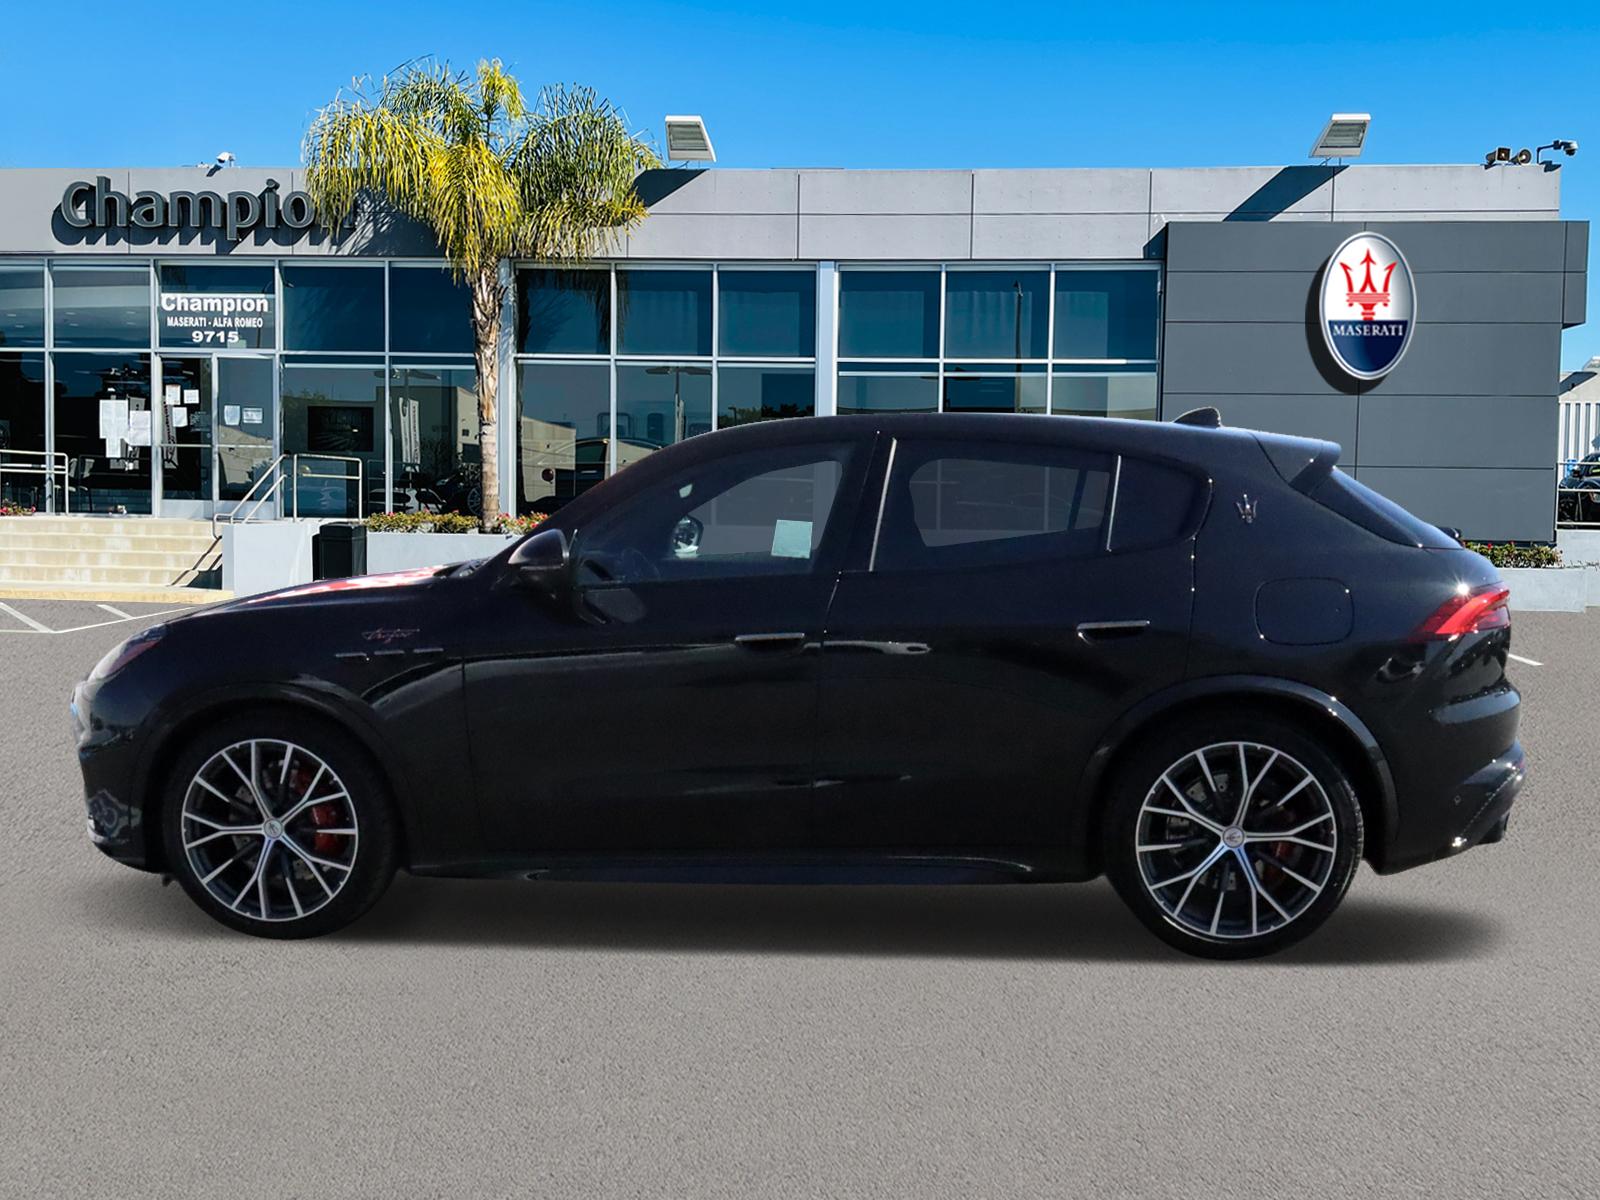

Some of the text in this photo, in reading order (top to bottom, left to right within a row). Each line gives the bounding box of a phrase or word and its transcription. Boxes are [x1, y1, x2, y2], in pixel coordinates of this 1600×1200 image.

[61, 176, 354, 241] Champio
[160, 293, 269, 315] Champion
[166, 316, 207, 327] MASERATI
[212, 317, 233, 327] ALFA
[234, 317, 264, 328] ROMEO
[191, 330, 240, 343] 9715
[1333, 324, 1403, 336] MASERATI
